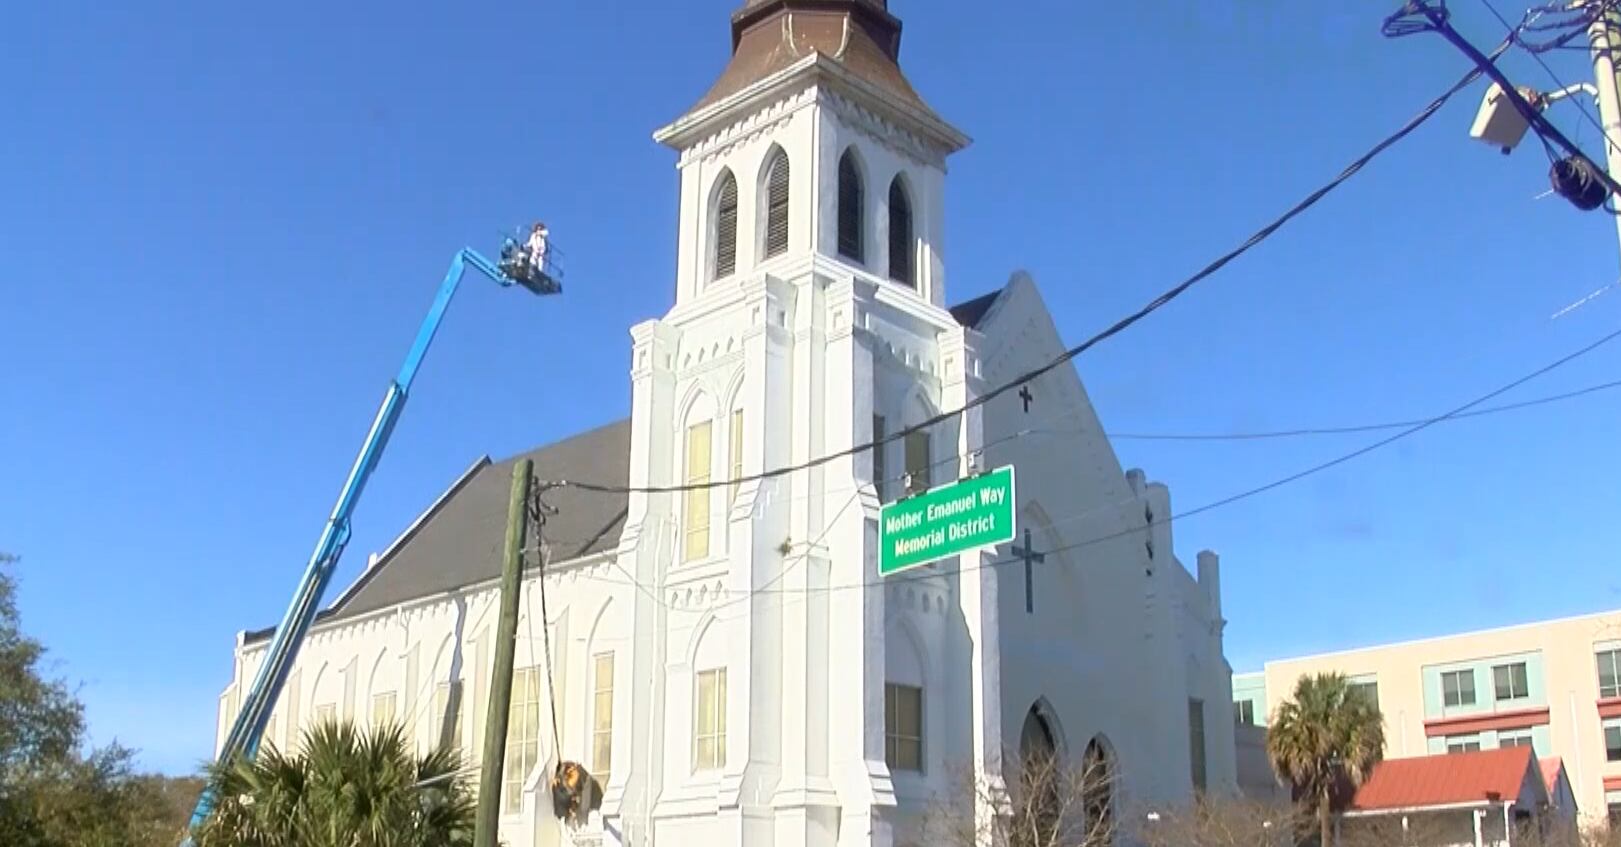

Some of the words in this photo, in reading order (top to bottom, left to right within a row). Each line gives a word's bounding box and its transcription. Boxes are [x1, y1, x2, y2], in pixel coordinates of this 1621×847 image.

[886, 511, 923, 534] Mother
[927, 491, 976, 521] Emanuel
[980, 486, 1005, 505] Way
[895, 527, 945, 557] Memorial
[948, 513, 995, 541] District
